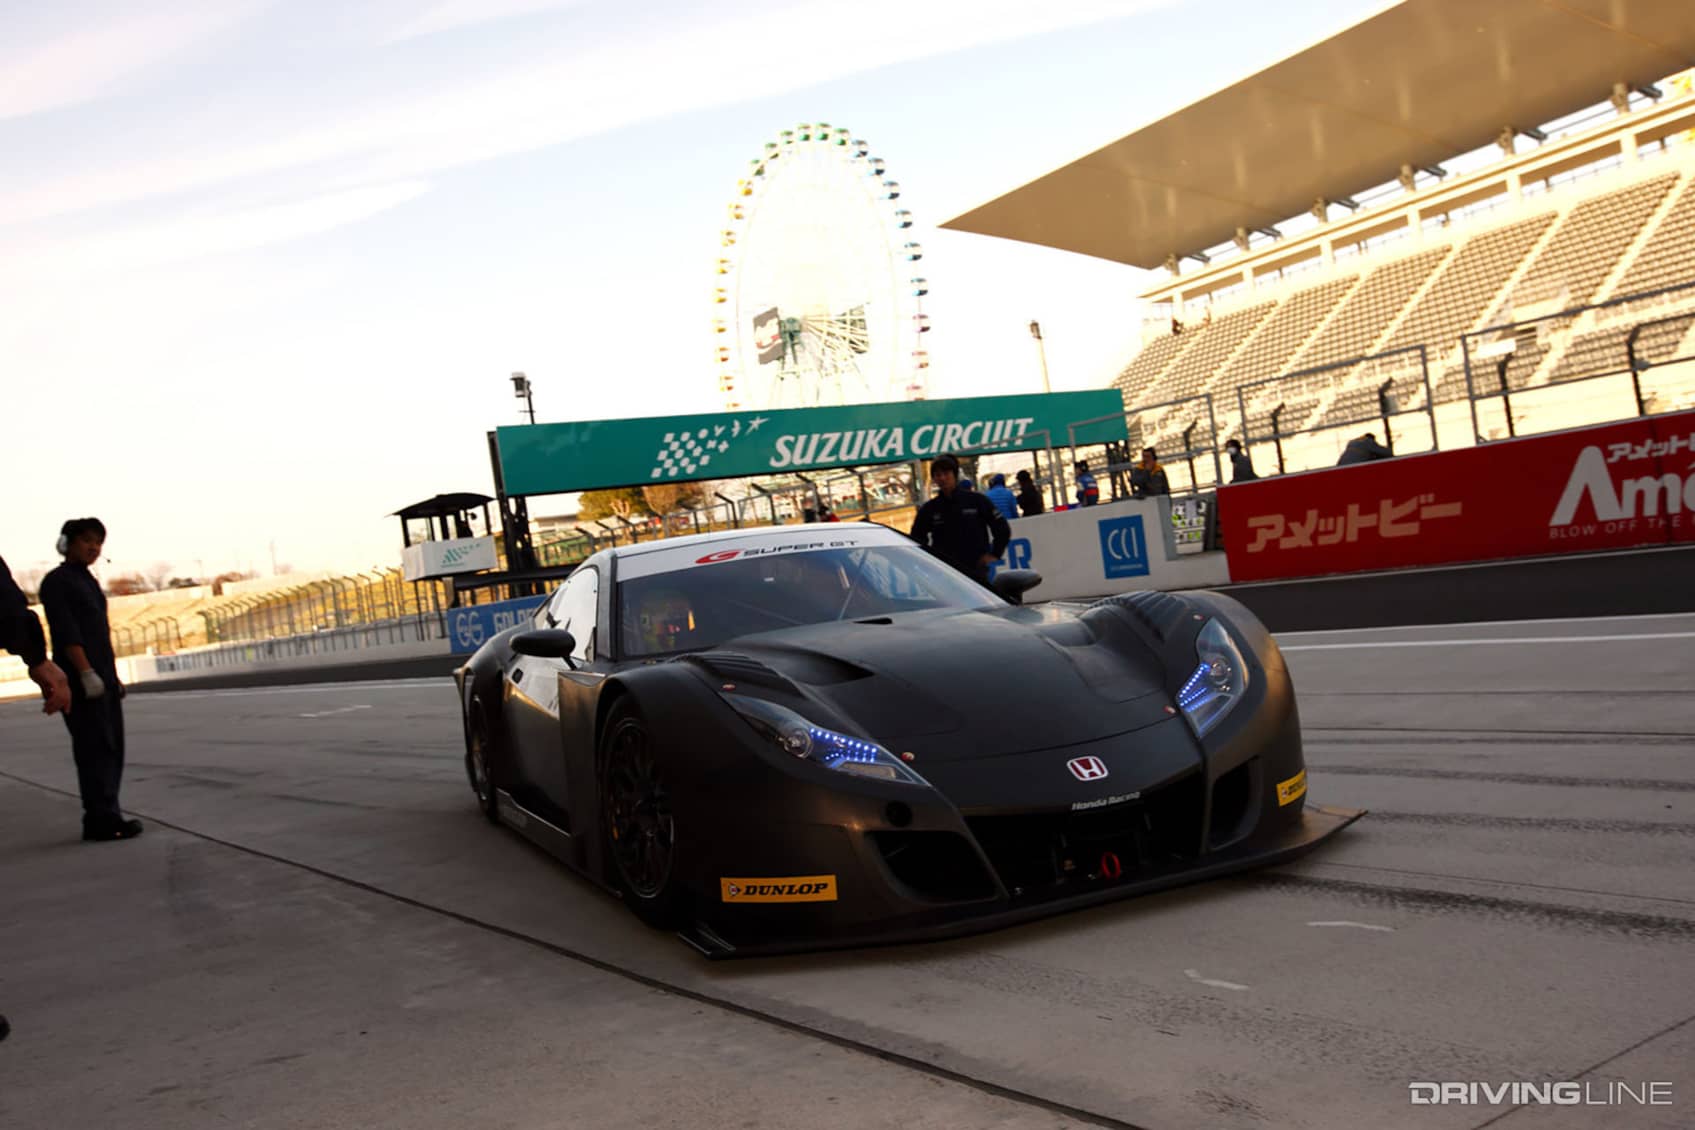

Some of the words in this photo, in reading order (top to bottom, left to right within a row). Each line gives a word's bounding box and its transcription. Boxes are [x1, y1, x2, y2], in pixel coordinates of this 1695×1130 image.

[769, 427, 905, 468] SUZUKA
[910, 417, 1034, 454] CIRCUIT
[1607, 431, 1695, 463] アメット
[1247, 493, 1463, 553] アメットビー
[1549, 525, 1597, 539] BLOW
[1604, 521, 1637, 534] OFF
[743, 542, 824, 557] SUPER
[1071, 799, 1107, 811] Honda
[743, 883, 829, 896] DUNLOP
